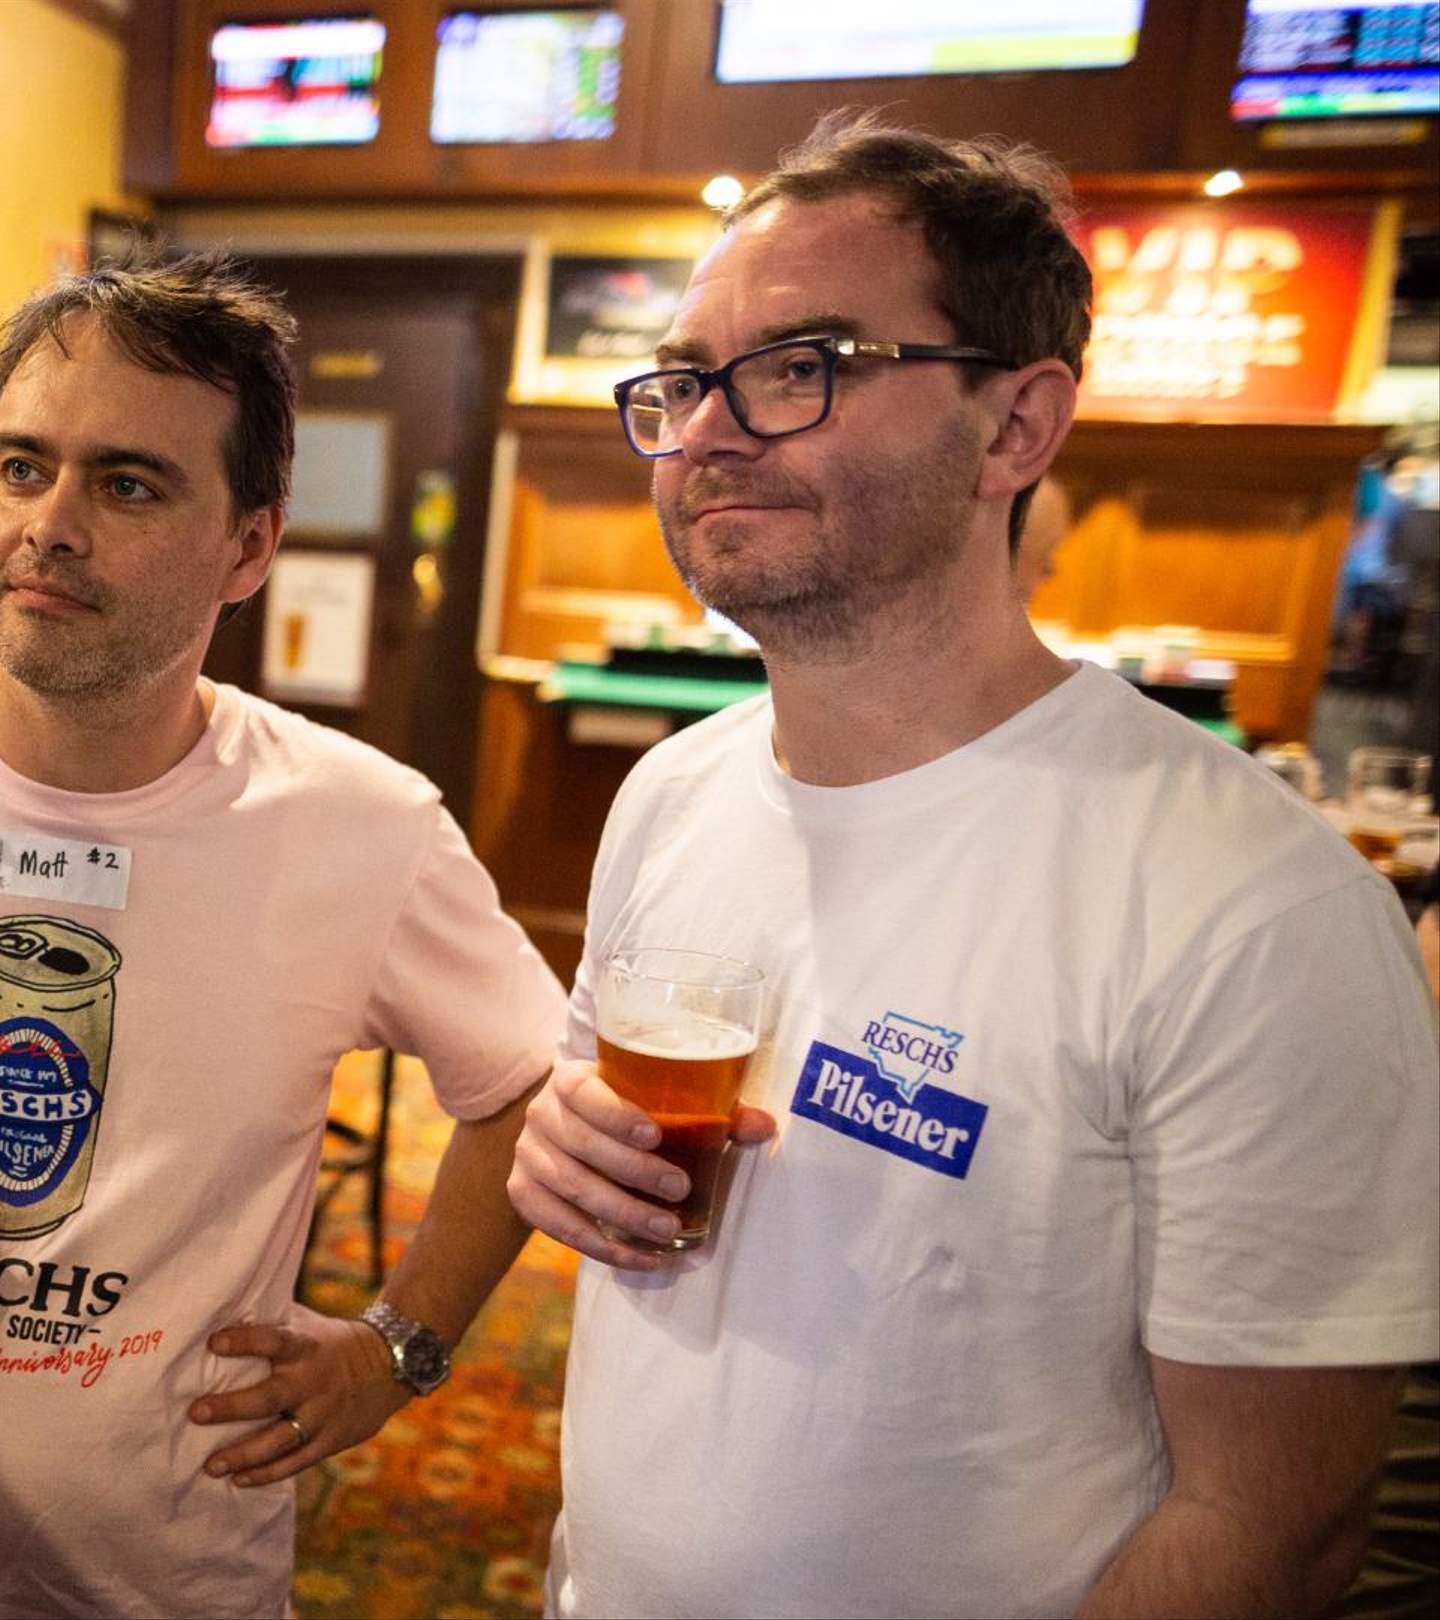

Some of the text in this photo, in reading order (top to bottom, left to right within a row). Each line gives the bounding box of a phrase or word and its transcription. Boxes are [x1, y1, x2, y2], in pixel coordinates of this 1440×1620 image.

[1091, 224, 1304, 273] VIP
[19, 849, 68, 879] Matt
[87, 846, 120, 870] #2
[861, 1020, 959, 1074] RESCHS
[807, 1058, 970, 1160] Pilsener
[118, 1330, 164, 1359] 2019
